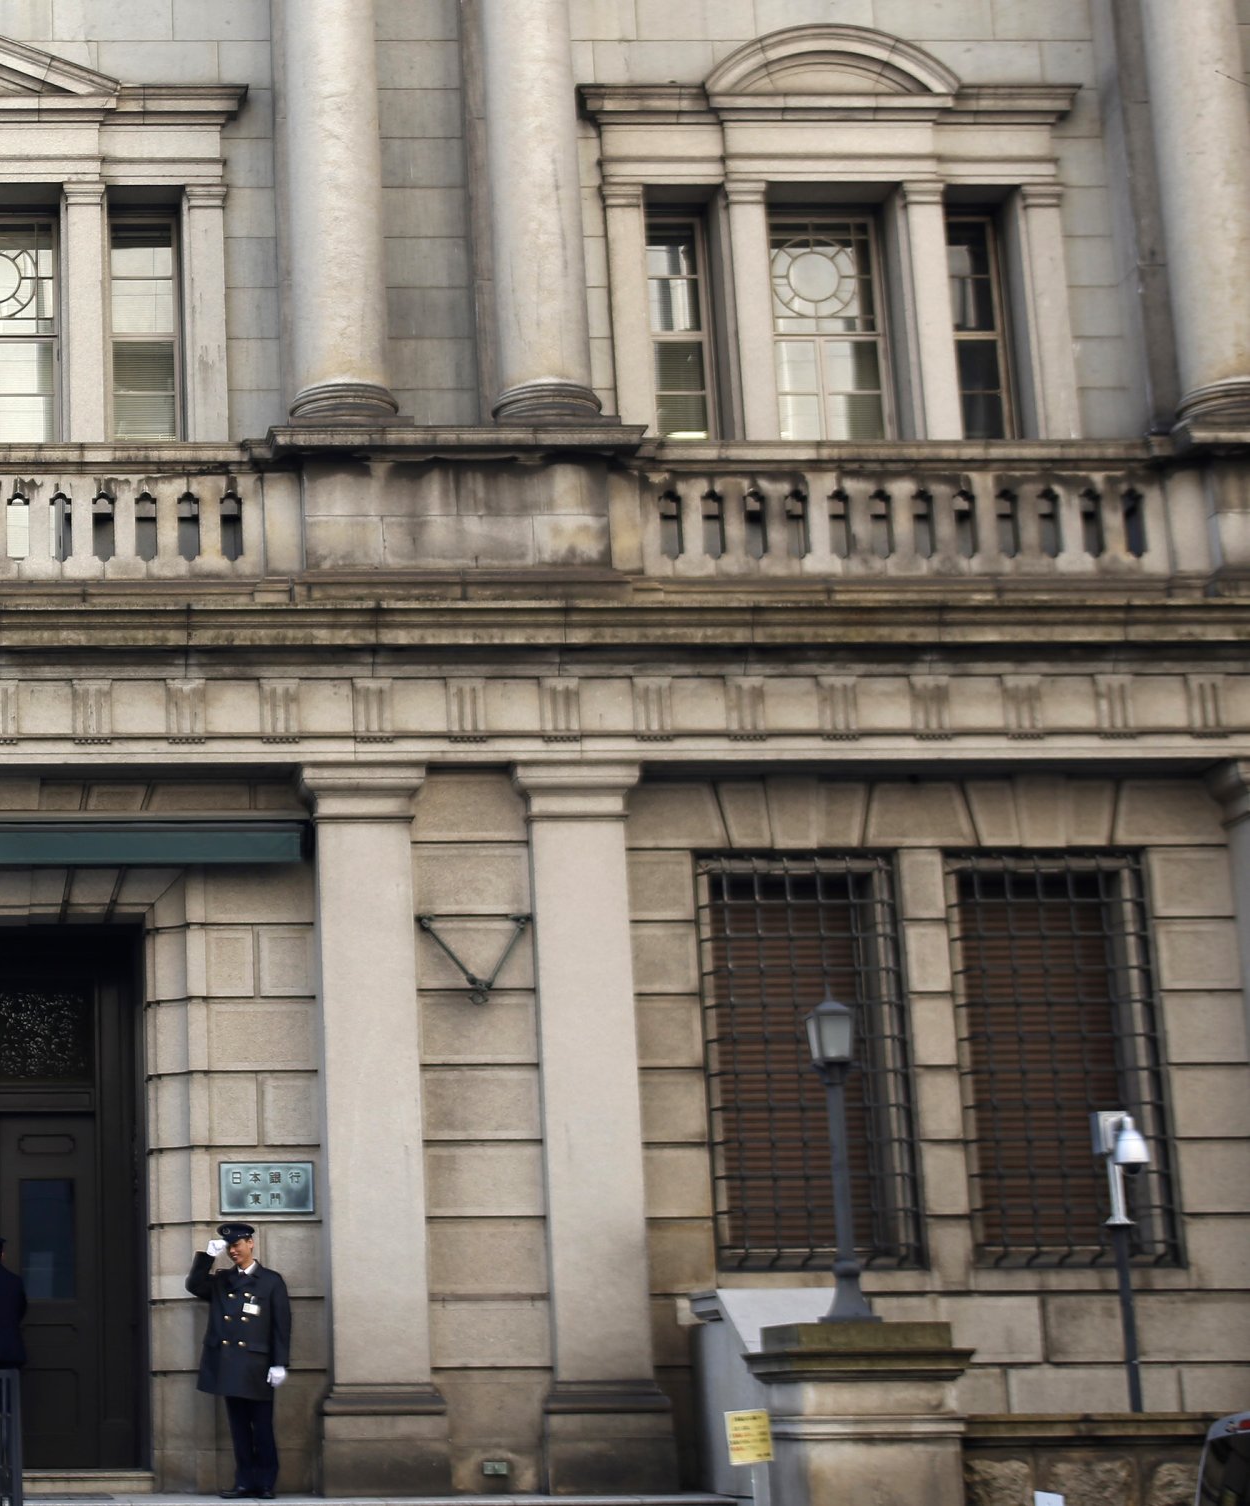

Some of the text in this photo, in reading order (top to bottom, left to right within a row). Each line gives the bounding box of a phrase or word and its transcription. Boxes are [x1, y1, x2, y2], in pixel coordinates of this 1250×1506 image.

[231, 1170, 301, 1185] 日本銀行
[249, 1191, 282, 1205] 東門
